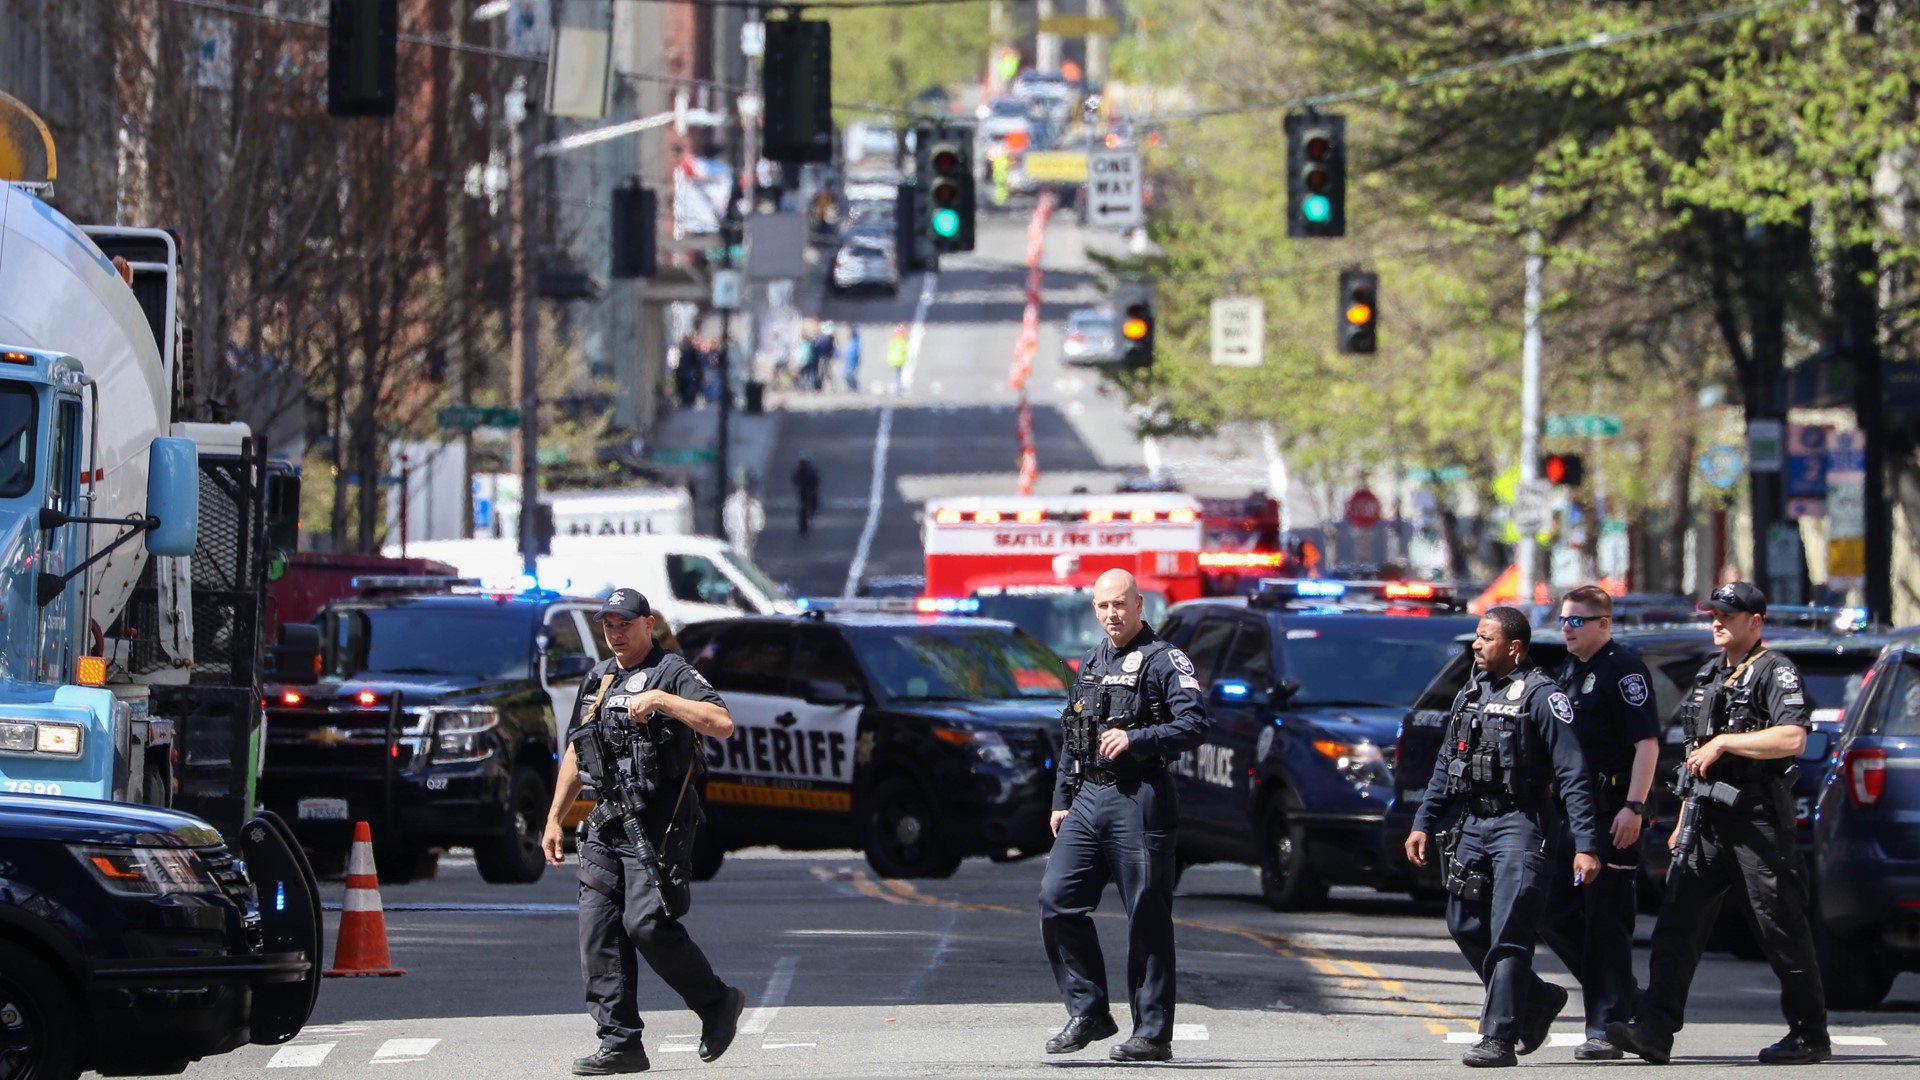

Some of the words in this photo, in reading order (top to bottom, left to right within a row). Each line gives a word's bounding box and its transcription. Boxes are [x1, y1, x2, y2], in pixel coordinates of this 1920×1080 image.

[1093, 157, 1131, 174] ONE
[1096, 181, 1133, 194] WAY
[995, 532, 1054, 547] SEATTLE
[1062, 532, 1091, 547] FIRE
[1101, 674, 1137, 686] POLICE
[1483, 703, 1520, 717] POLICE
[704, 725, 847, 778] SHERIFF
[1197, 743, 1235, 788] POLICE
